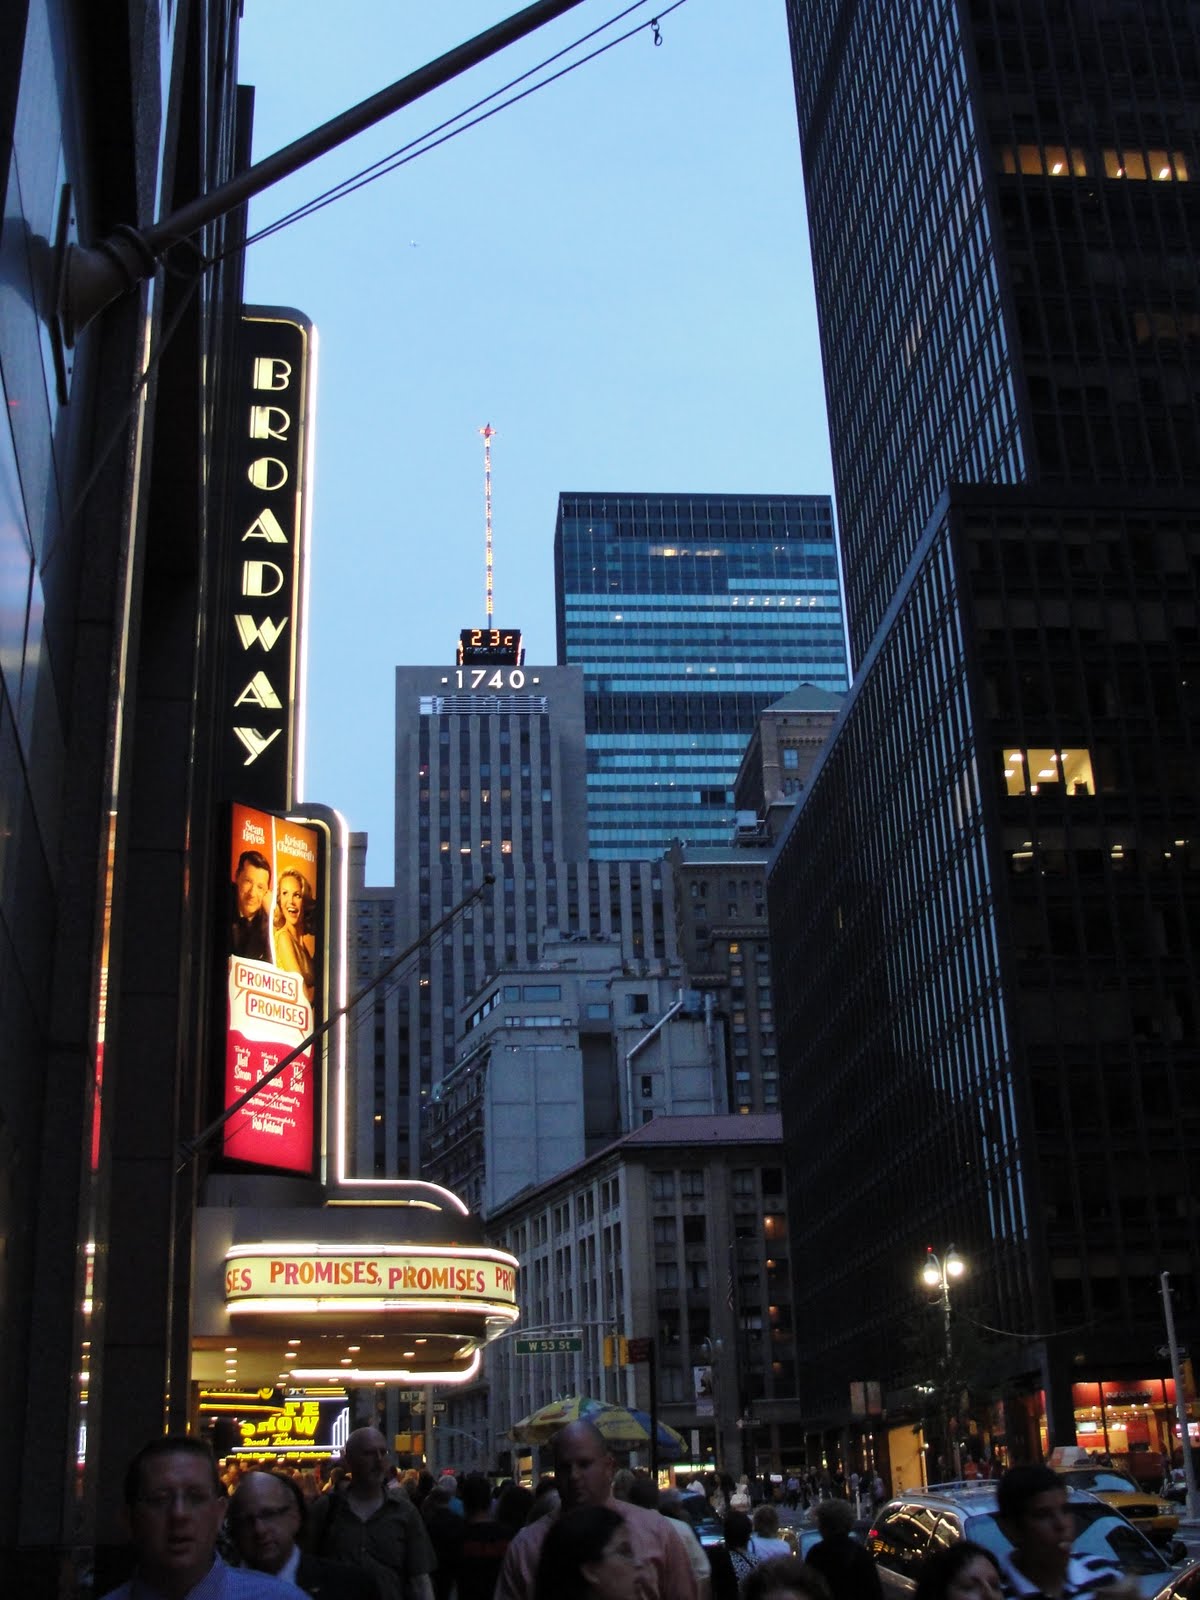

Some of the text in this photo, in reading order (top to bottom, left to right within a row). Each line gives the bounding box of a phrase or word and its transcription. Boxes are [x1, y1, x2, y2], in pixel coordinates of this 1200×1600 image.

[233, 357, 292, 766] BROADWAY
[456, 669, 525, 689] 1740
[242, 829, 265, 845] Hayes
[245, 820, 264, 837] Sean
[284, 834, 308, 852] Kristin
[239, 968, 296, 998] PROMISES,
[250, 998, 304, 1026] PROMISES
[234, 1064, 252, 1081] Simon
[226, 1268, 252, 1293] SES
[270, 1261, 382, 1287] PROMISES,
[388, 1266, 485, 1293] PROMISES
[528, 1340, 570, 1351] W 53 St
[243, 1437, 270, 1446] David
